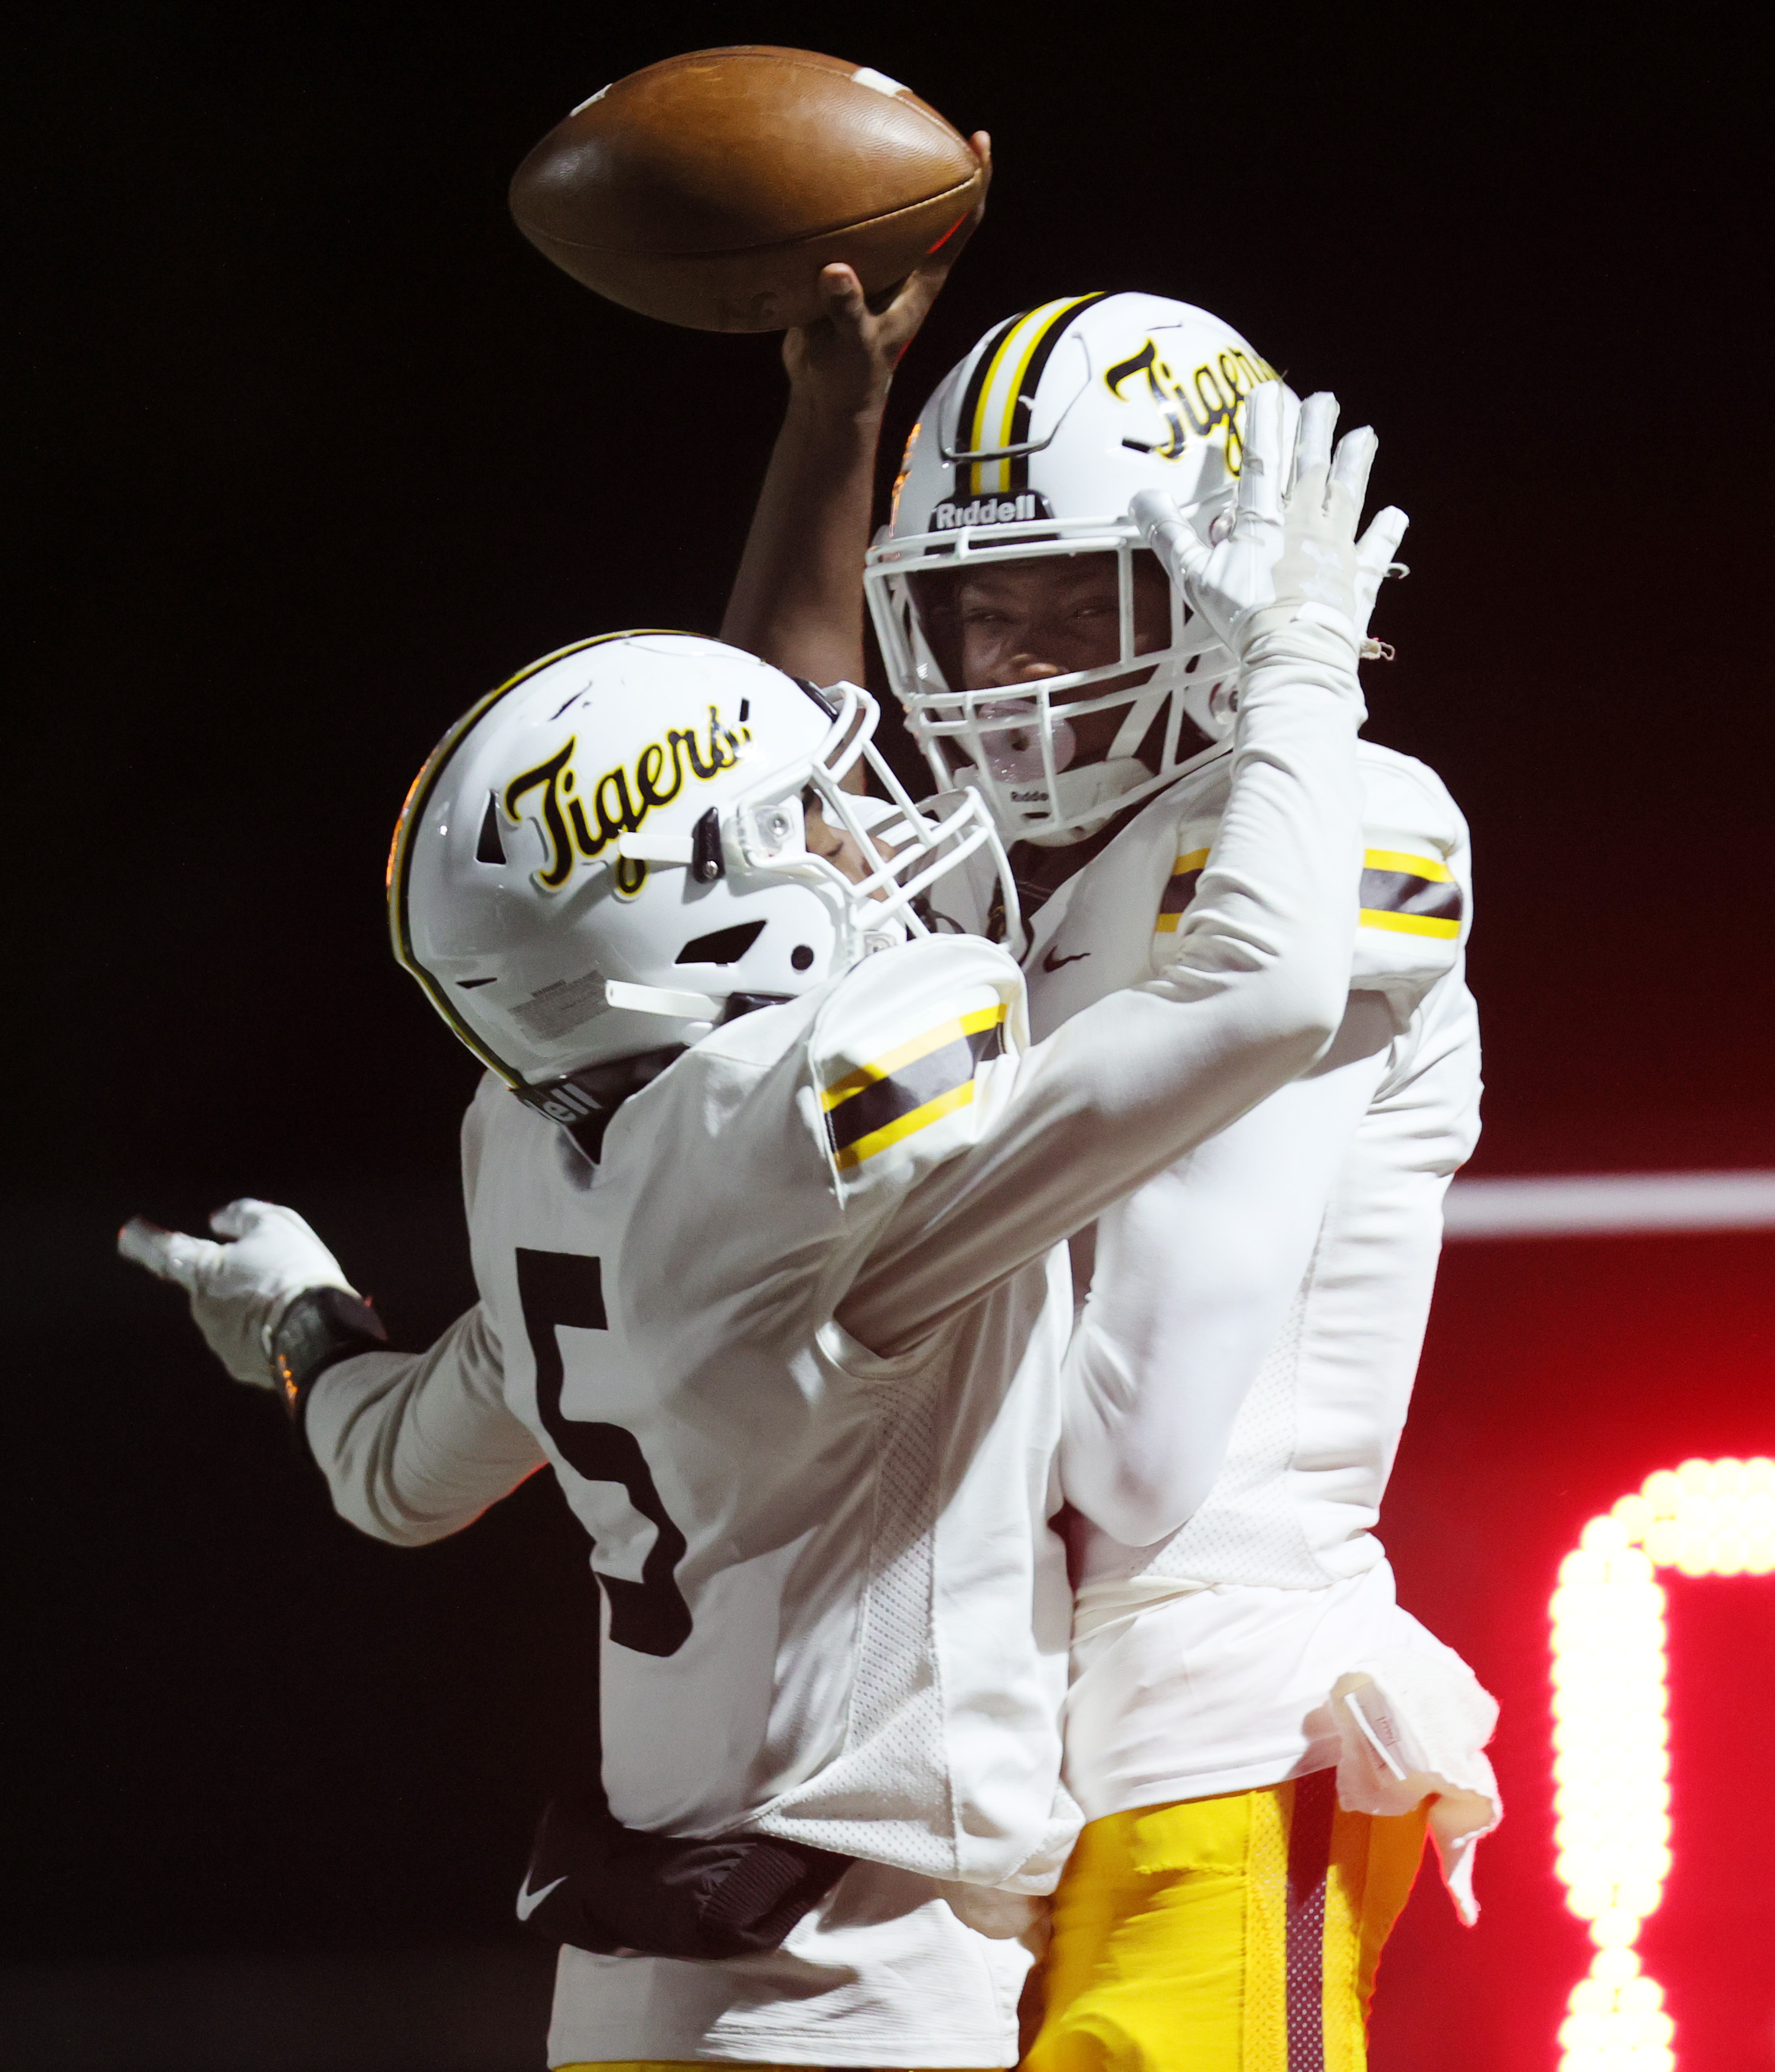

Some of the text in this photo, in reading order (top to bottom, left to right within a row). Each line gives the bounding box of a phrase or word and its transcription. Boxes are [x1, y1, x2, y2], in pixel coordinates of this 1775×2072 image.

[937, 494, 1035, 529] Riddell
[504, 703, 752, 895] Tigers
[515, 1247, 693, 1658] 5
